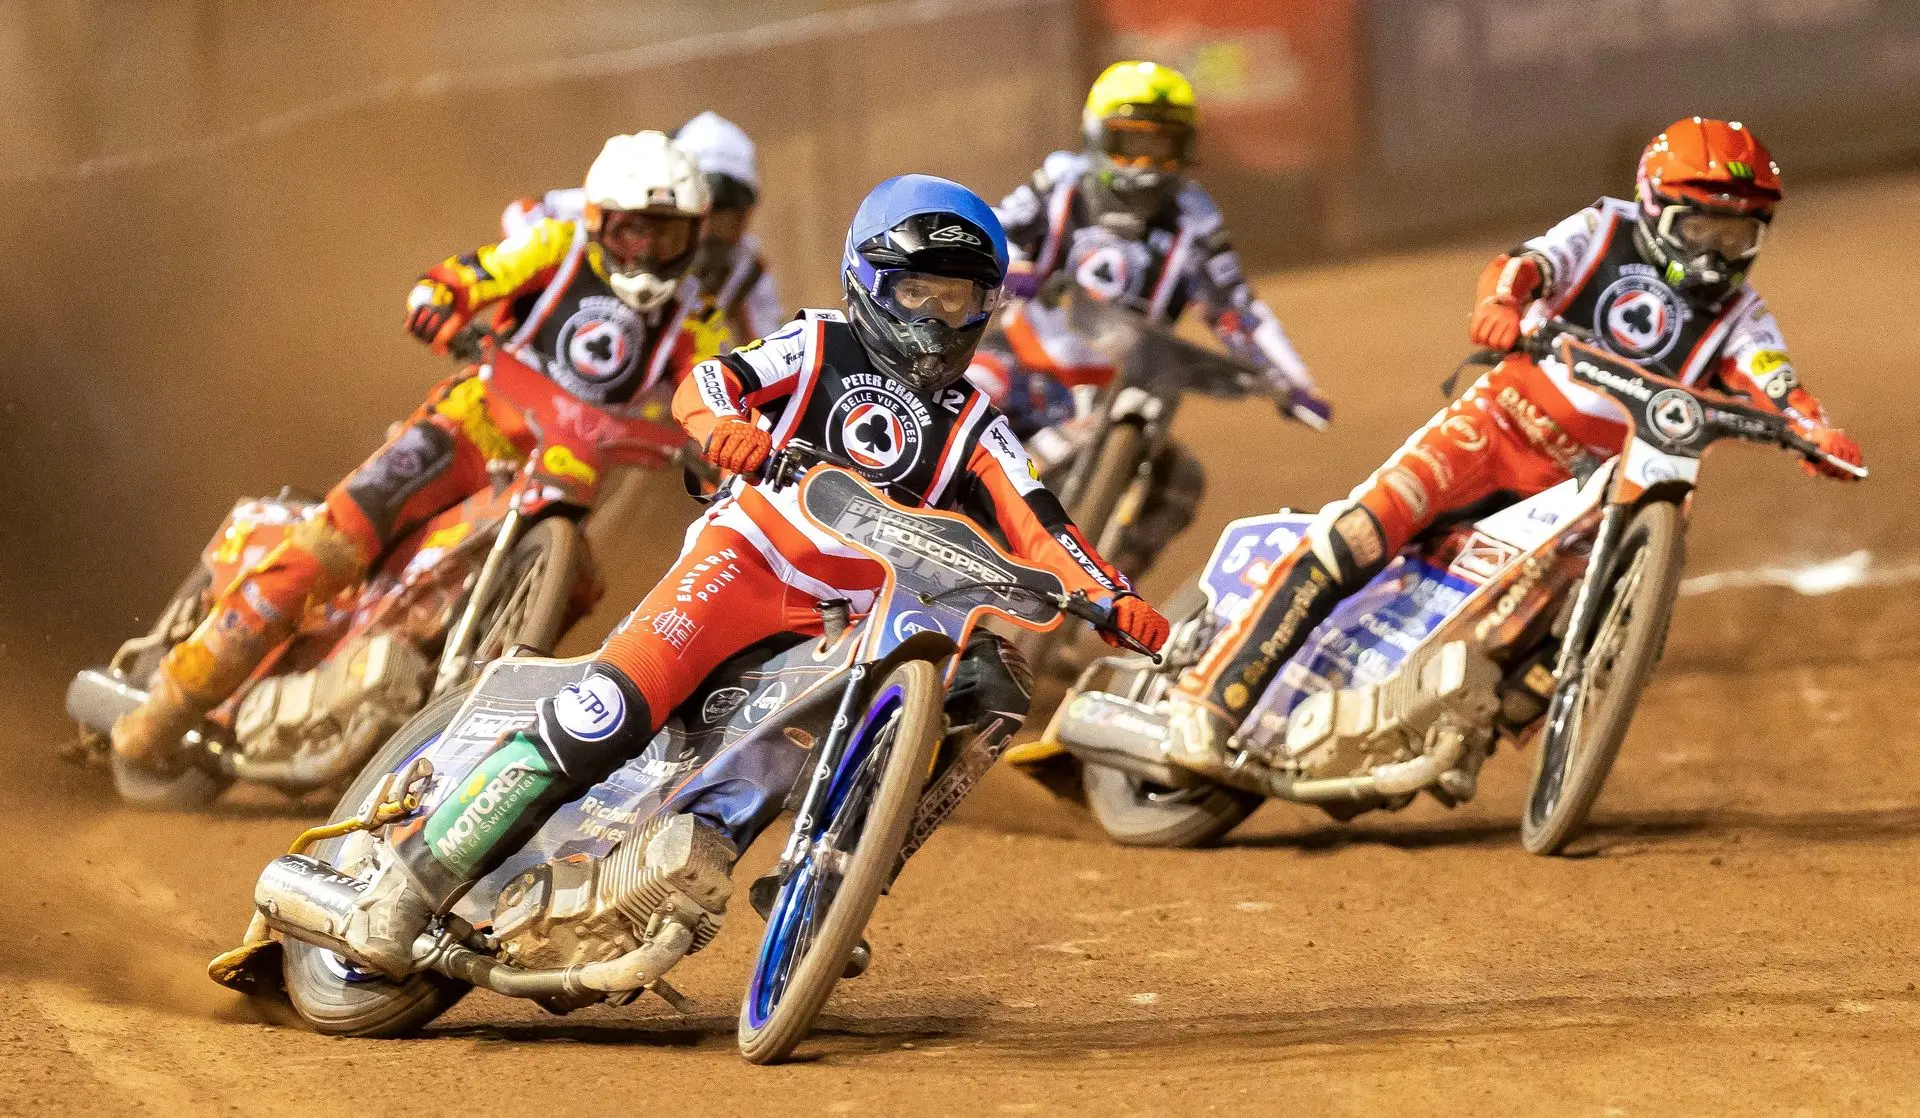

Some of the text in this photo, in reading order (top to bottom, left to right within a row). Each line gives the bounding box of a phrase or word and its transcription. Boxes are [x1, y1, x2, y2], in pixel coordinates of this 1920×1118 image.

[840, 392, 917, 443] BELLE VUE ACES
[841, 373, 933, 427] PETER CRAVEN
[932, 388, 965, 414] 12
[696, 563, 741, 602] POINT
[577, 689, 610, 724] TPI
[480, 772, 540, 833] Switzerlan
